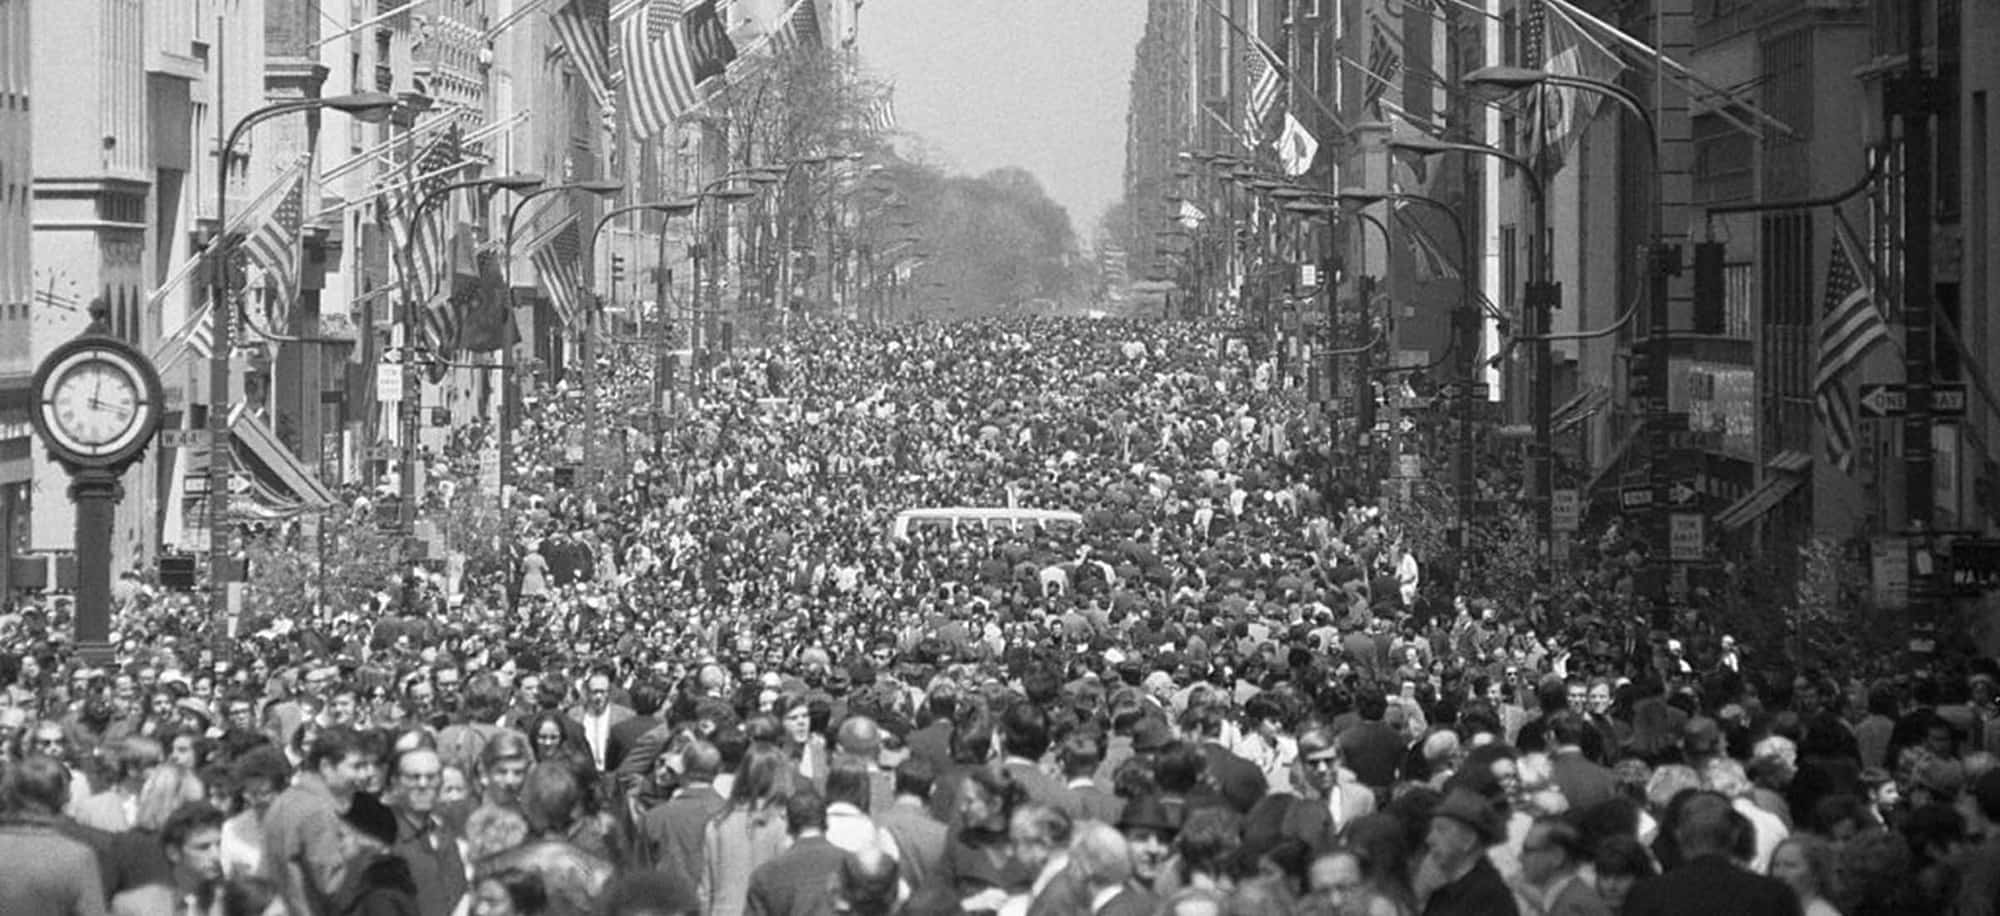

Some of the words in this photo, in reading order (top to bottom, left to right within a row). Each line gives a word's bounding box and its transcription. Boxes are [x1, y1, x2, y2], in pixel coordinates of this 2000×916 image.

[1875, 393, 1905, 409] ONE
[165, 432, 175, 444] W
[179, 432, 197, 445] 44
